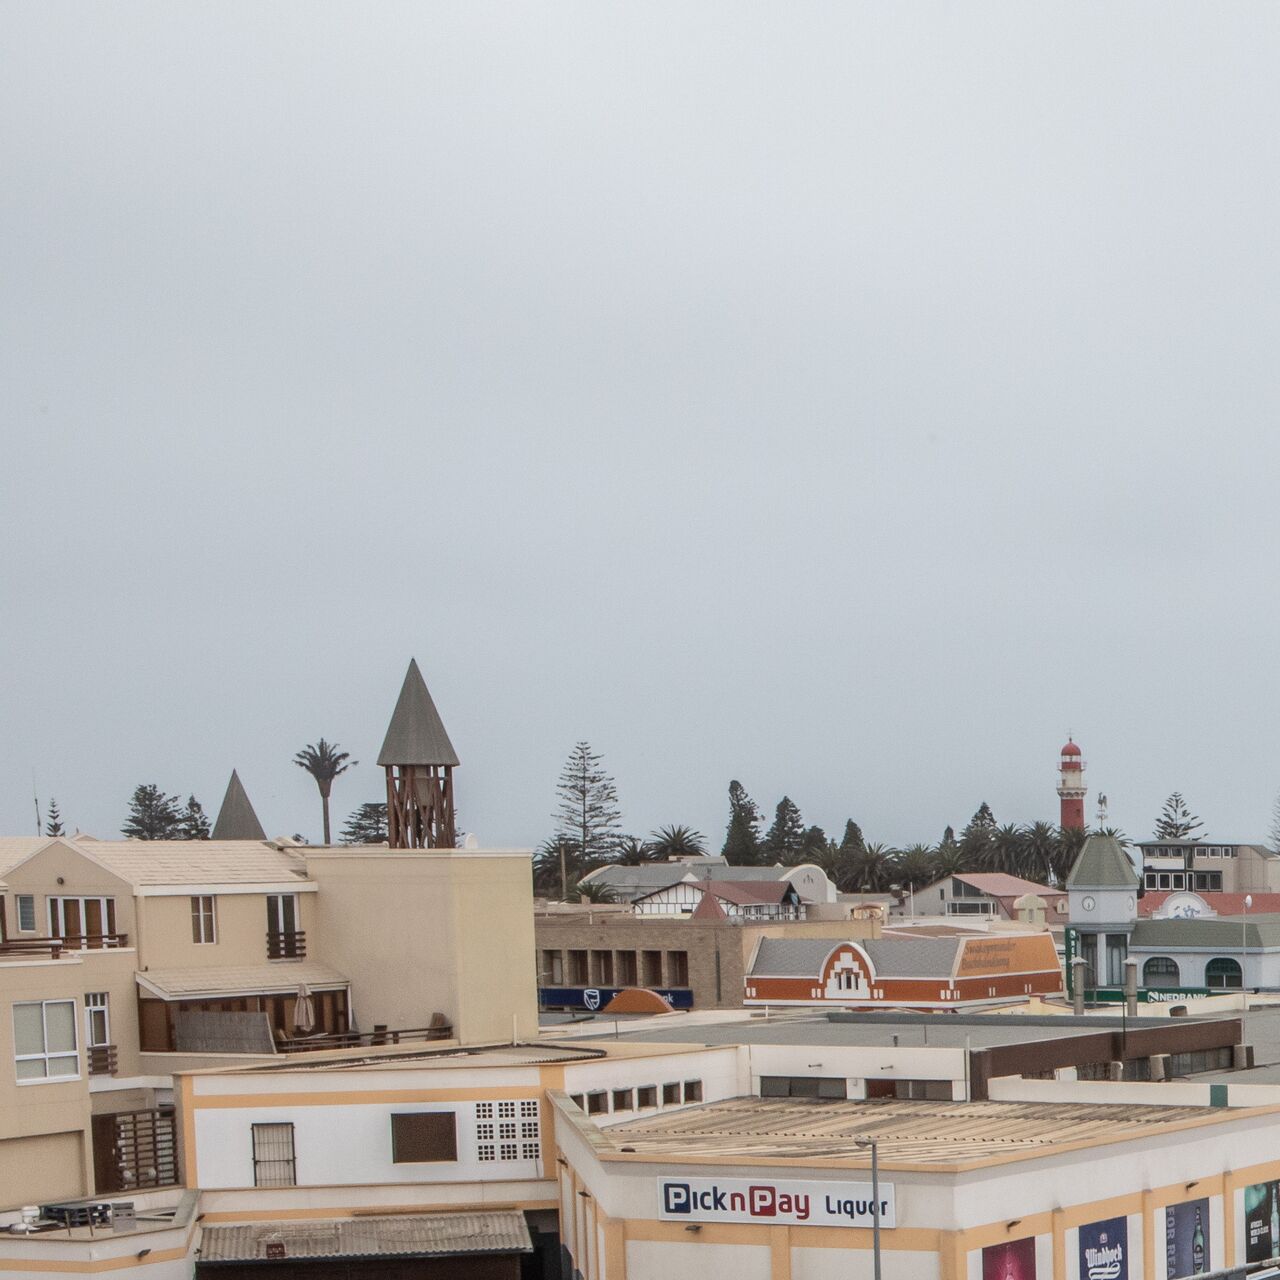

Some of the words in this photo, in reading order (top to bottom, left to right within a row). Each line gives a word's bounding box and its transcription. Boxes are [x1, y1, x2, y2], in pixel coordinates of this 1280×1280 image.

[1159, 992, 1207, 1001] NEDBANK
[664, 1183, 727, 1214] Pick
[731, 1193, 745, 1211] n
[749, 1185, 810, 1220] Pay
[825, 1195, 888, 1219] Liquor
